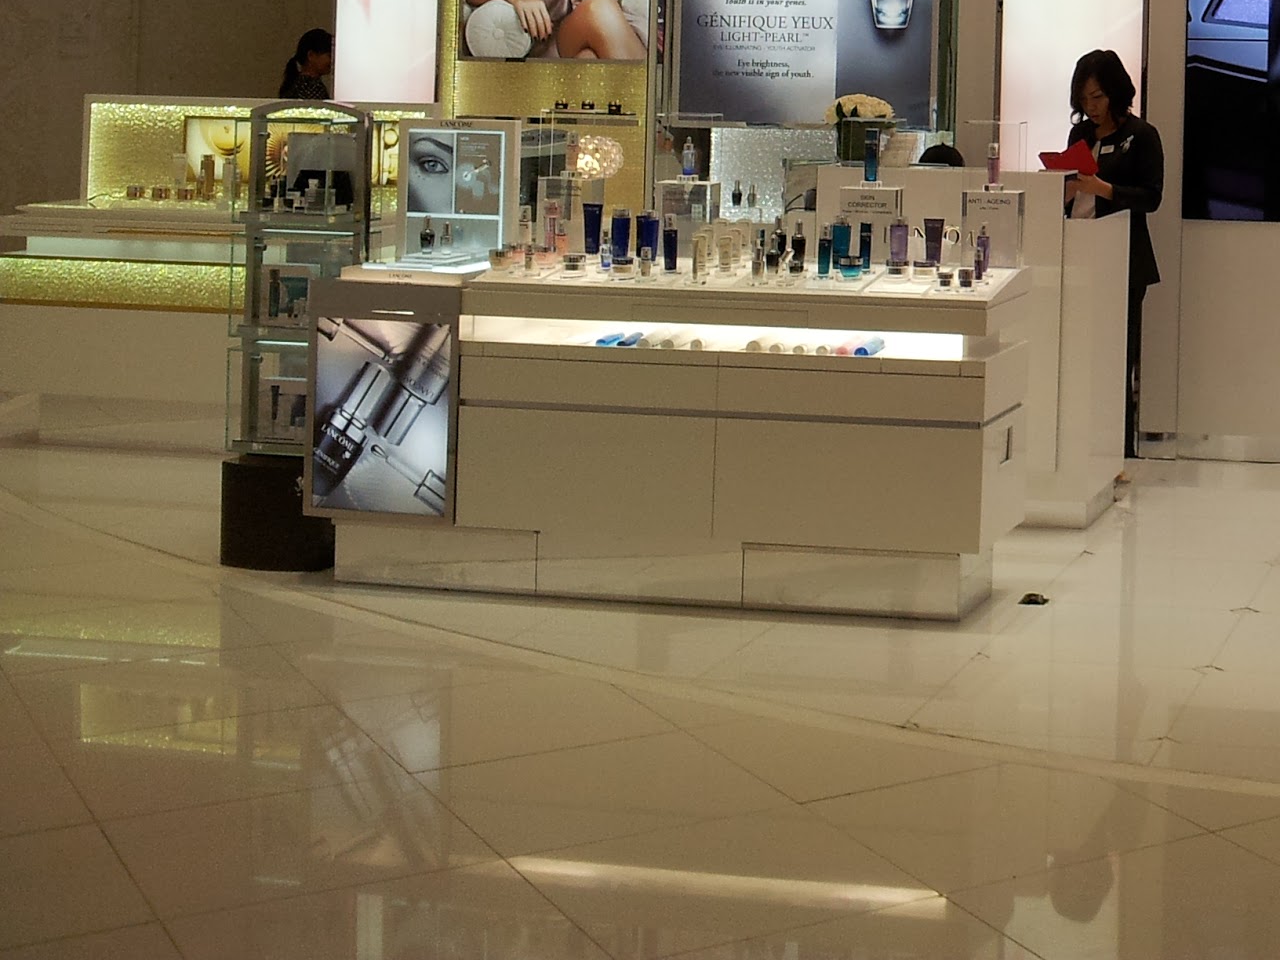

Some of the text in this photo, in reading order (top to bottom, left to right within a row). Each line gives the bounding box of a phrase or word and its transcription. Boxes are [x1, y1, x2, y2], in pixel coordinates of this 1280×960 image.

[784, 0, 807, 8] genes.
[696, 11, 834, 32] GÉNIFIQUE YEUX
[737, 59, 751, 69] Eye
[741, 69, 763, 77] visible
[765, 70, 780, 80] sign
[781, 69, 790, 77] of
